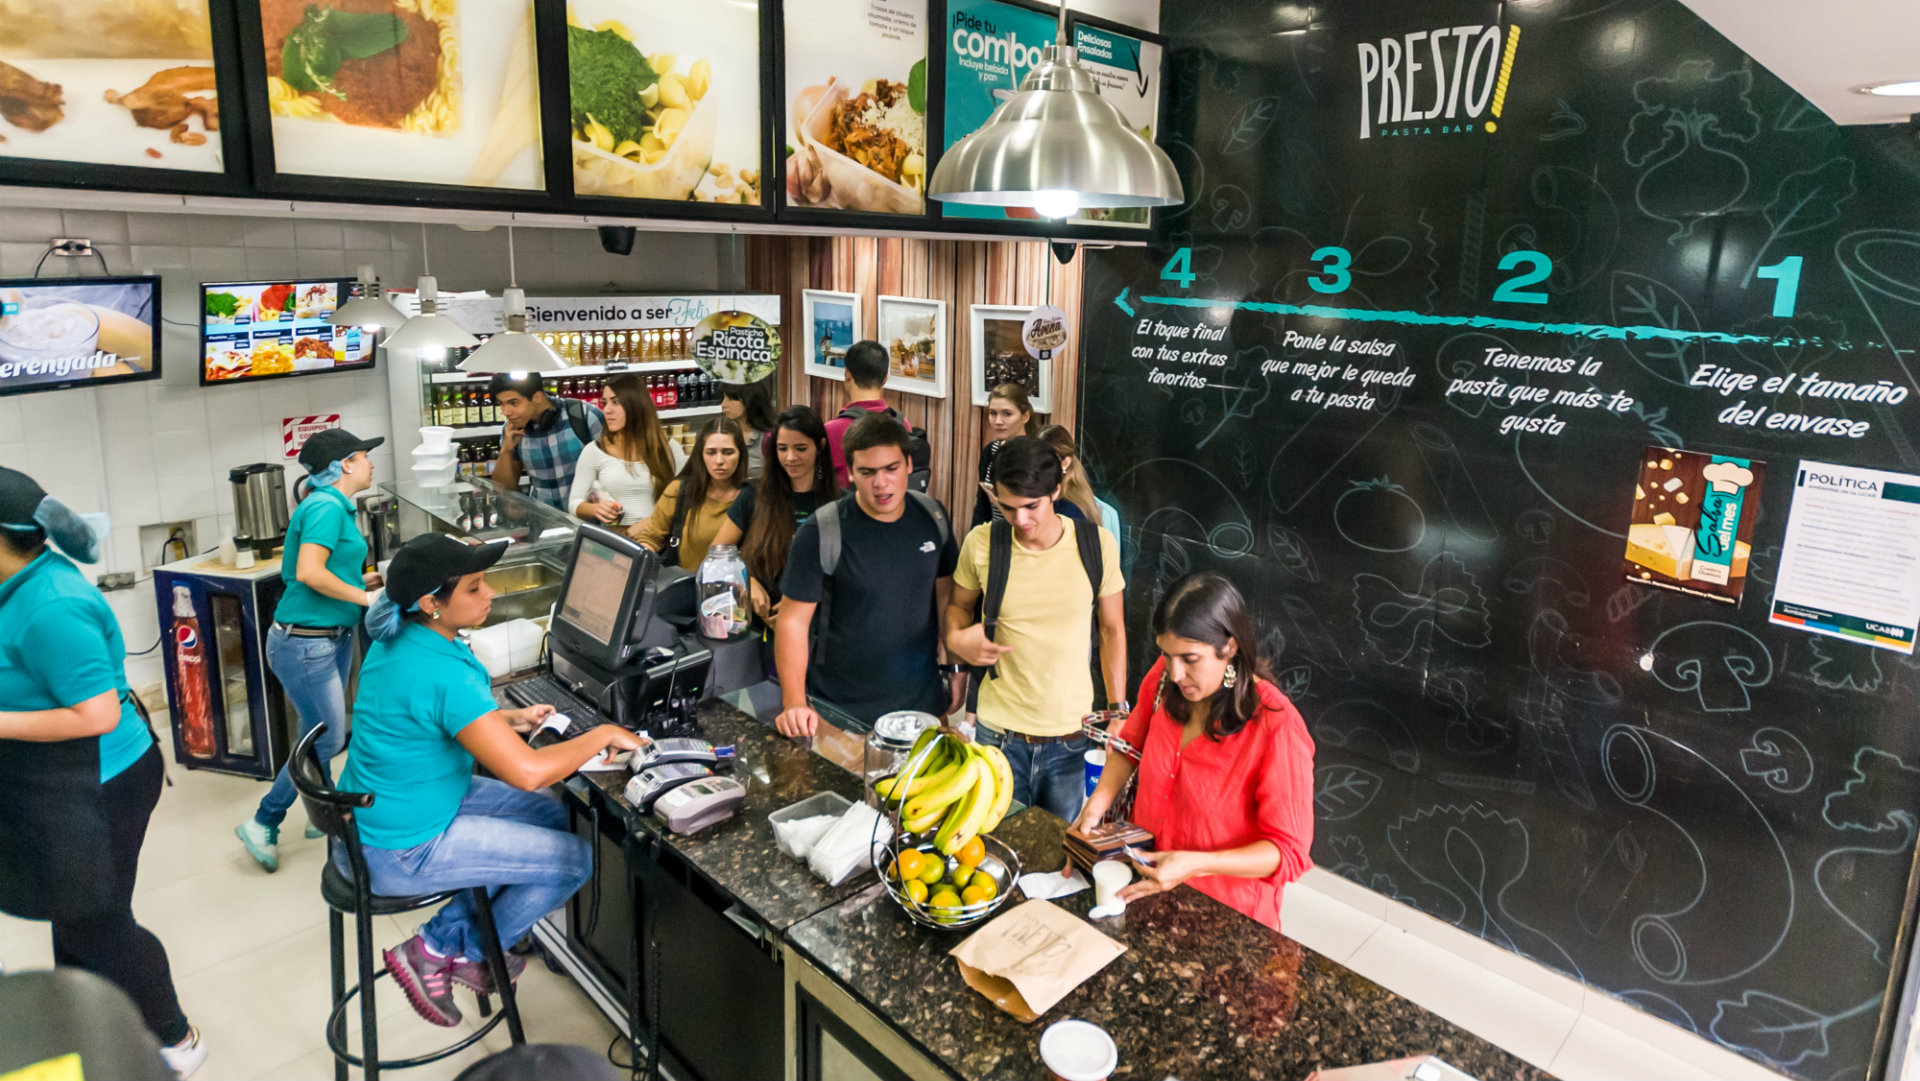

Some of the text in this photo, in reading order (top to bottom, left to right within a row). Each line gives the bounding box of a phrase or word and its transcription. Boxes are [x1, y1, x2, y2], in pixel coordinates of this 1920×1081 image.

[984, 20, 996, 34] tu
[1078, 30, 1112, 49] Deliciosas
[1078, 41, 1112, 60] Ensaladas
[959, 56, 1009, 75] Incluye bebida
[984, 73, 998, 81] pan
[1381, 124, 1474, 136] PASTA BAR
[1160, 247, 1196, 288] 4
[1307, 246, 1352, 294] 3
[1492, 250, 1553, 304] 2
[1757, 256, 1803, 318] 1
[631, 308, 642, 320] a
[646, 308, 673, 319] ser
[713, 330, 765, 350] Ricota
[729, 326, 764, 338] Pasticho
[1137, 319, 1227, 341] El toque final
[696, 341, 772, 363] Espinaca
[1282, 330, 1397, 357] Ponle la salsa
[1132, 344, 1228, 367] con tus extras
[1483, 347, 1603, 377] Tenemos la
[1148, 368, 1208, 390] favoritos
[1260, 357, 1416, 388] que mejor le queda
[1444, 376, 1636, 412] pasta que más te
[1689, 363, 1909, 405] Elige el tamaño
[1290, 385, 1376, 411] a tu pasta
[297, 424, 328, 433] EQUIPOS
[1499, 413, 1567, 436] gusta
[1718, 400, 1871, 439] del envase
[1808, 473, 1878, 492] POLÍTICA
[1693, 496, 1723, 558] Salsa
[1722, 502, 1738, 531] mes
[1865, 622, 1891, 634] UCAB
